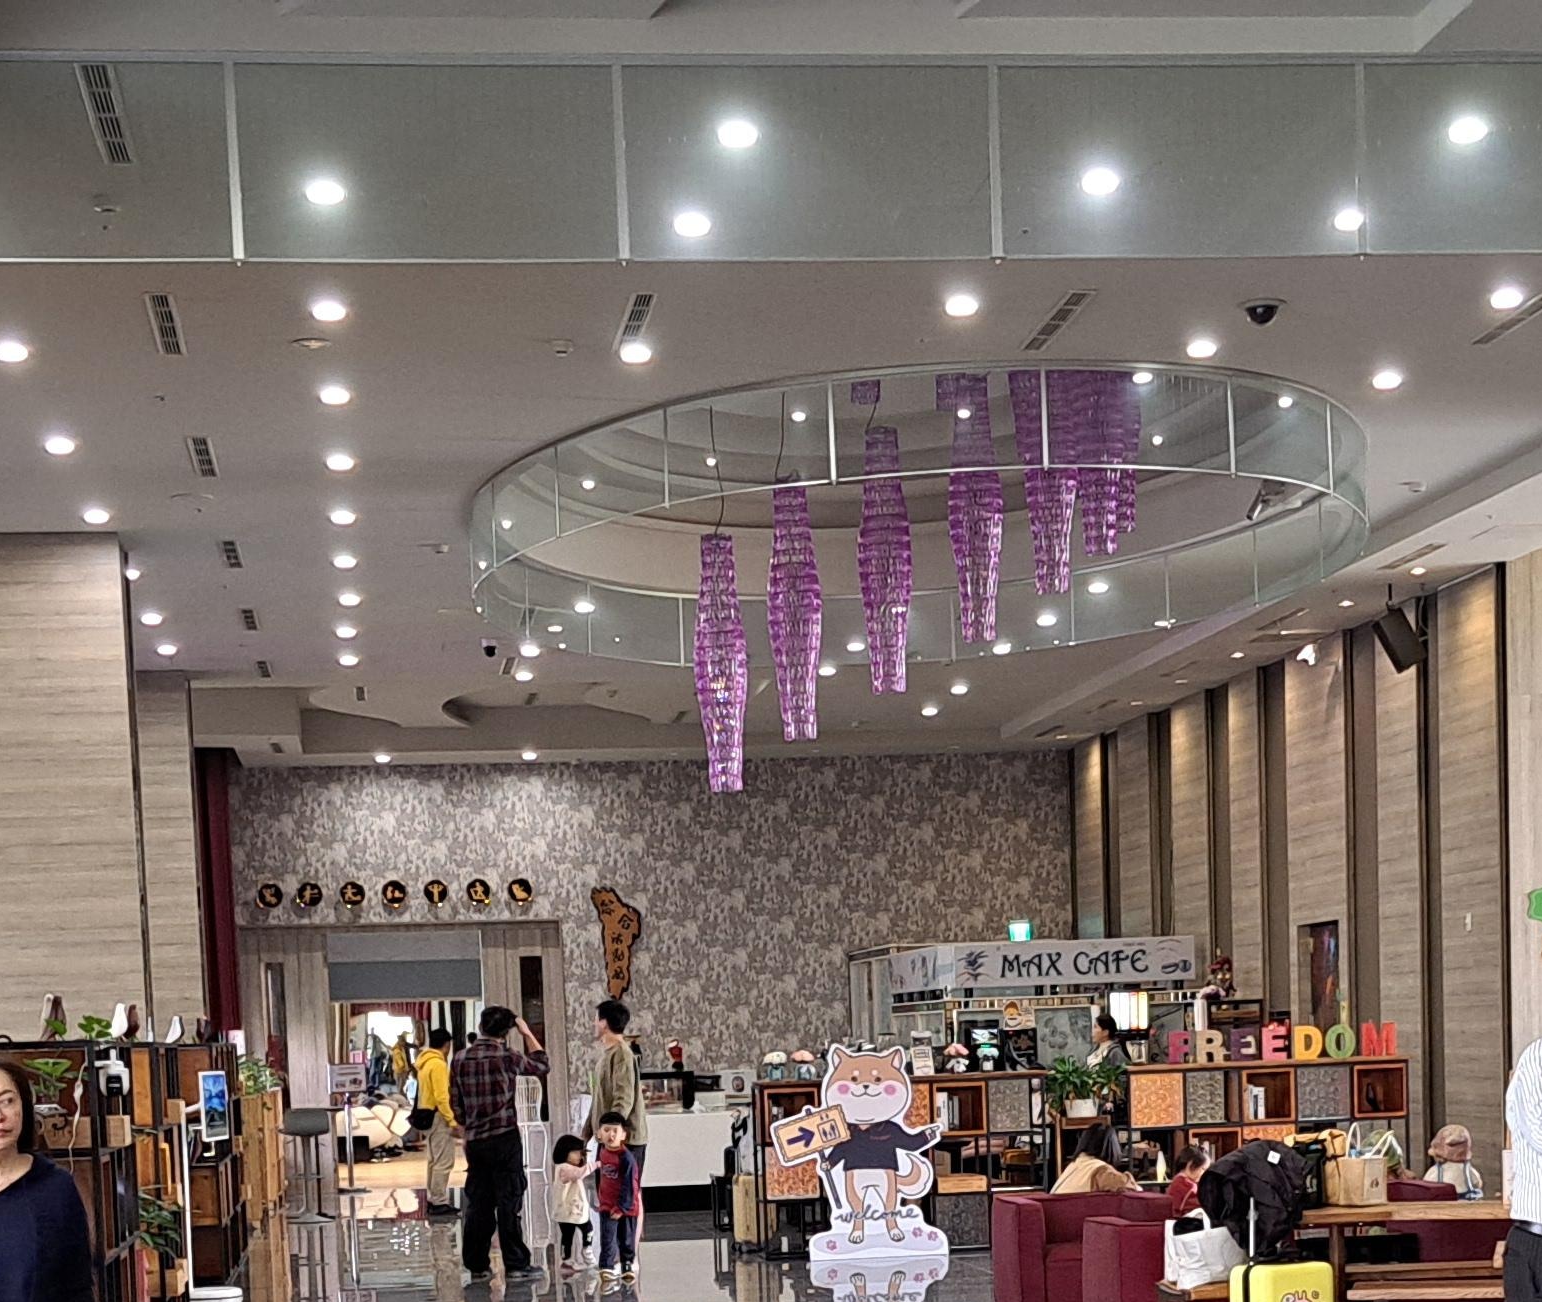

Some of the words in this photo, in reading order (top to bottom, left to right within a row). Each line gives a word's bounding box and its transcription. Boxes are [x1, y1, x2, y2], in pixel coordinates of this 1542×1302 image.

[999, 951, 1063, 979] MAX
[1073, 948, 1150, 976] CAFE
[1167, 1020, 1398, 1064] FREEDOM
[834, 1203, 920, 1224] welcome
